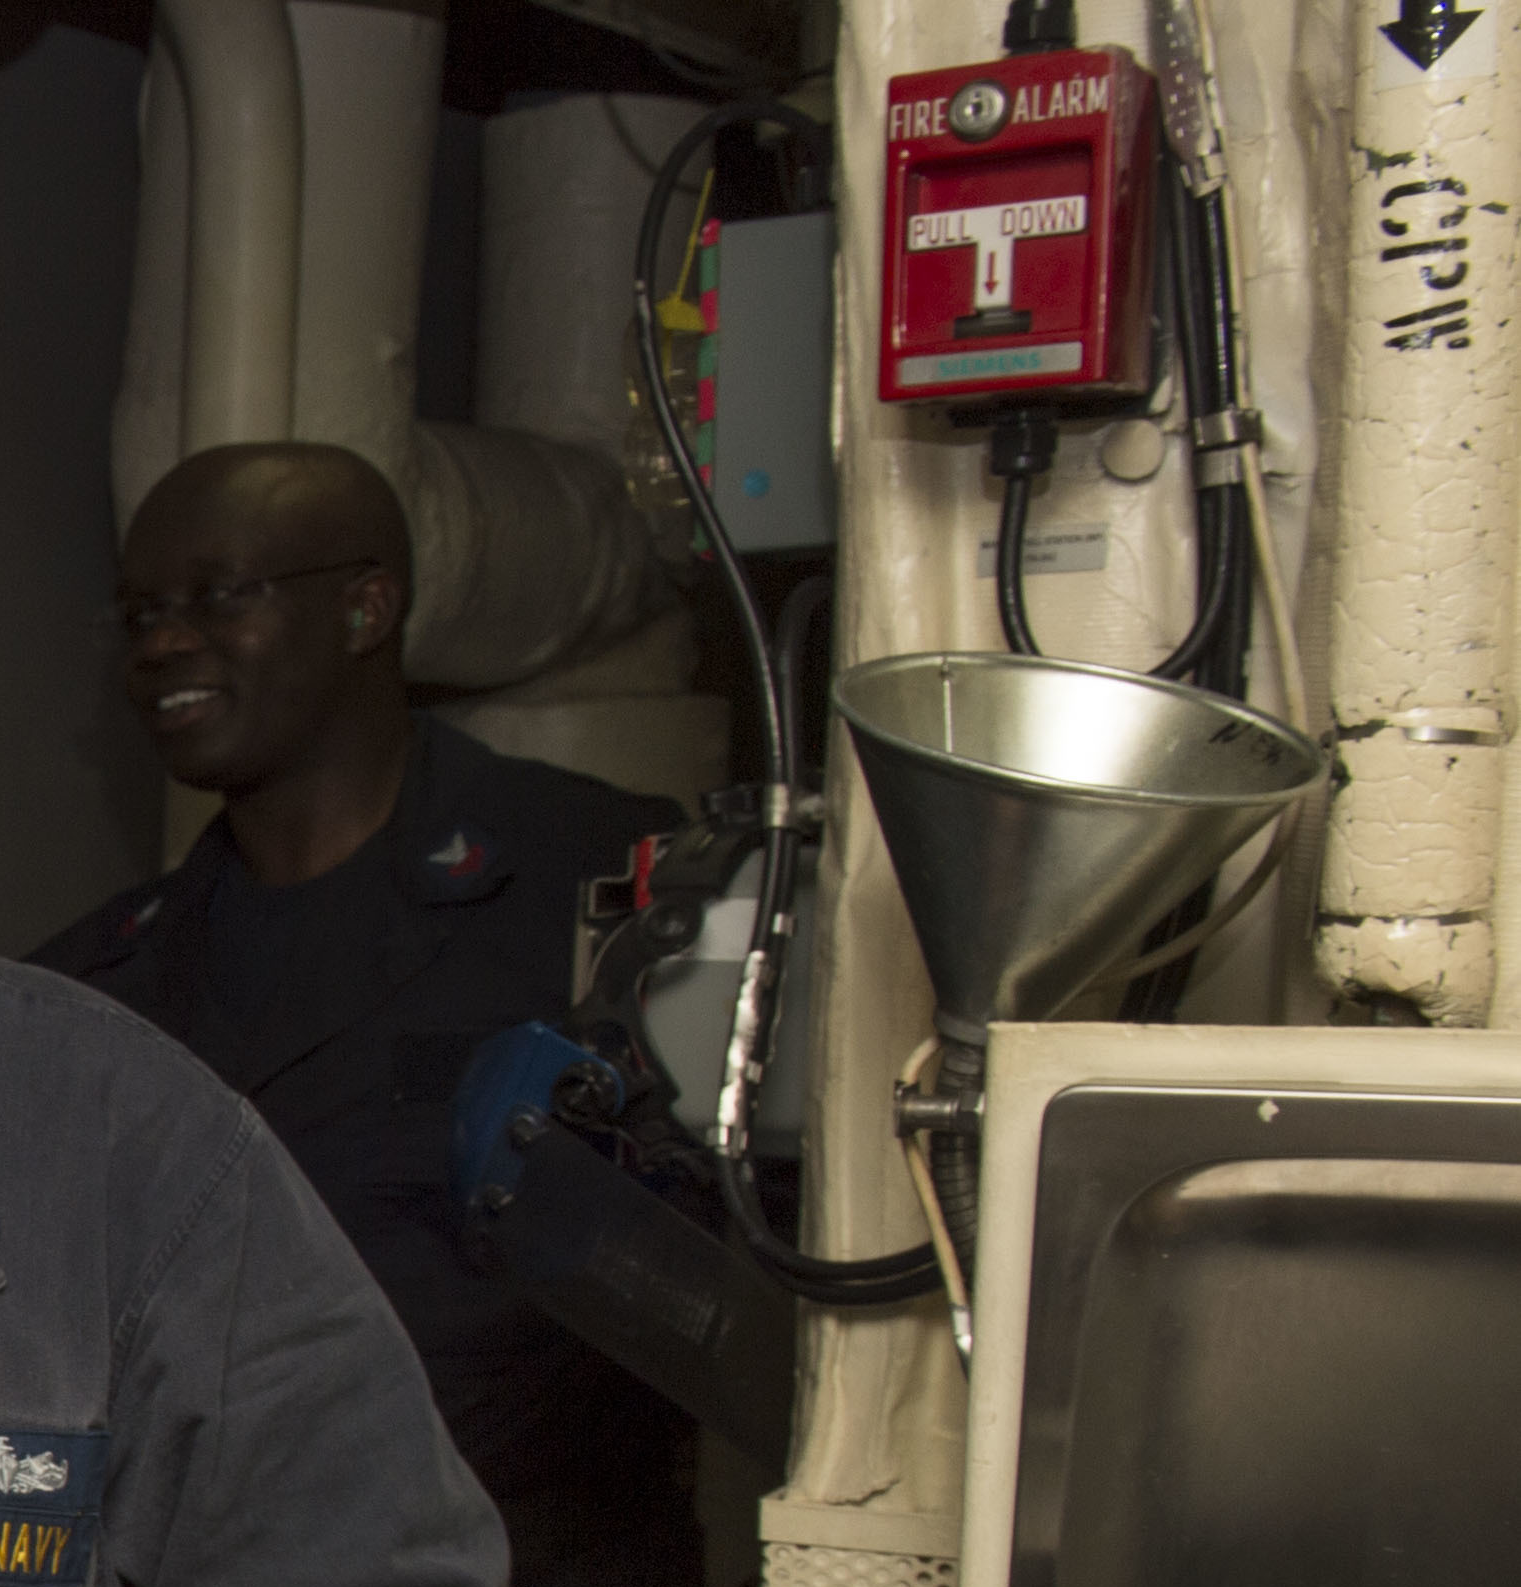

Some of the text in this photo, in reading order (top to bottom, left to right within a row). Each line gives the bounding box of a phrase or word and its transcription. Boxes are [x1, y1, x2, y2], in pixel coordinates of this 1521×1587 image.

[888, 74, 1110, 142] FIRE ALARM
[913, 200, 1080, 247] PULL DOWN
[938, 351, 1043, 377] SIEMENS
